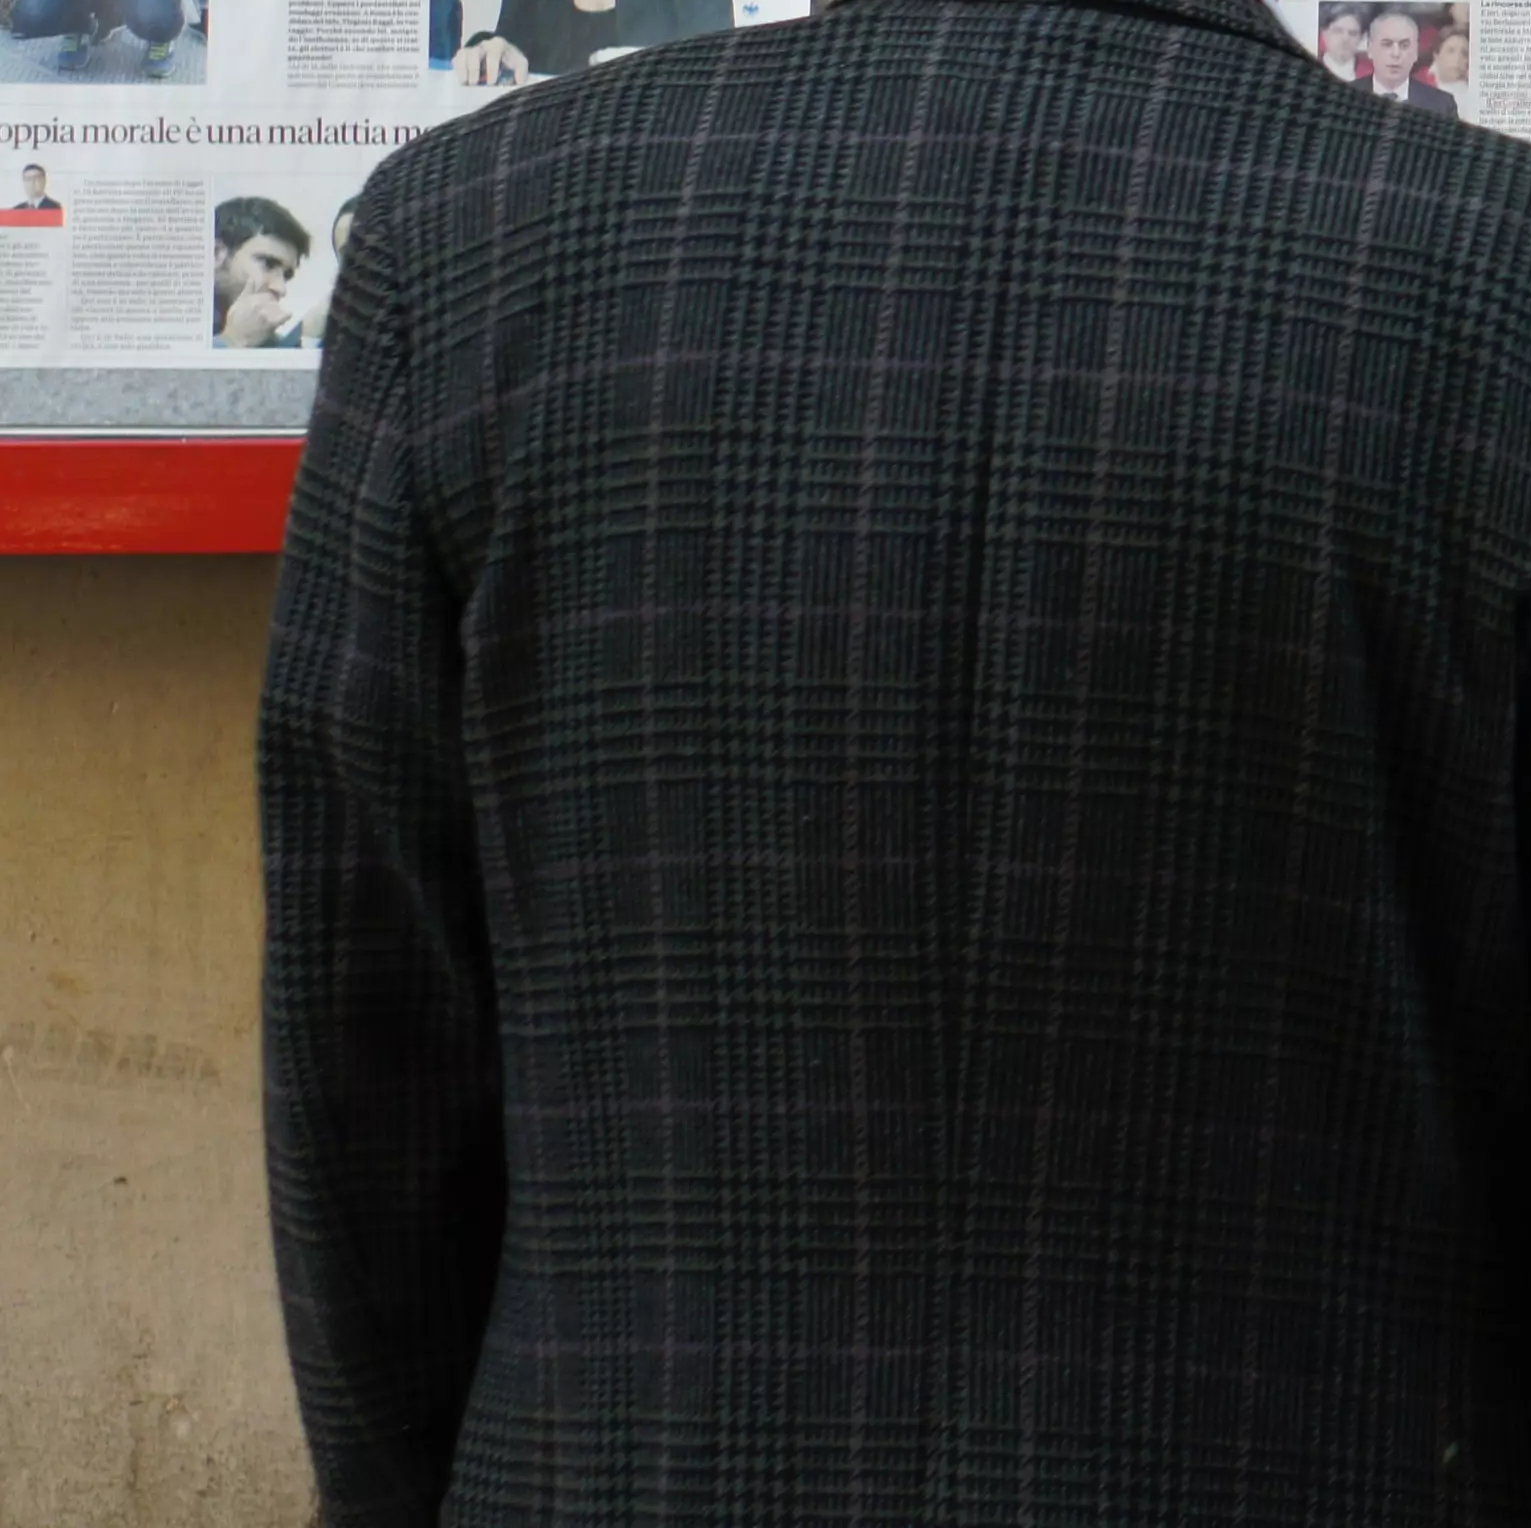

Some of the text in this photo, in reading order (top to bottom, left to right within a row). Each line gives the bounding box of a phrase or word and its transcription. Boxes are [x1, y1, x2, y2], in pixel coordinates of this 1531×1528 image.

[82, 116, 181, 144] morale
[185, 117, 202, 145] è
[207, 125, 261, 144] una
[268, 117, 387, 145] malattia
